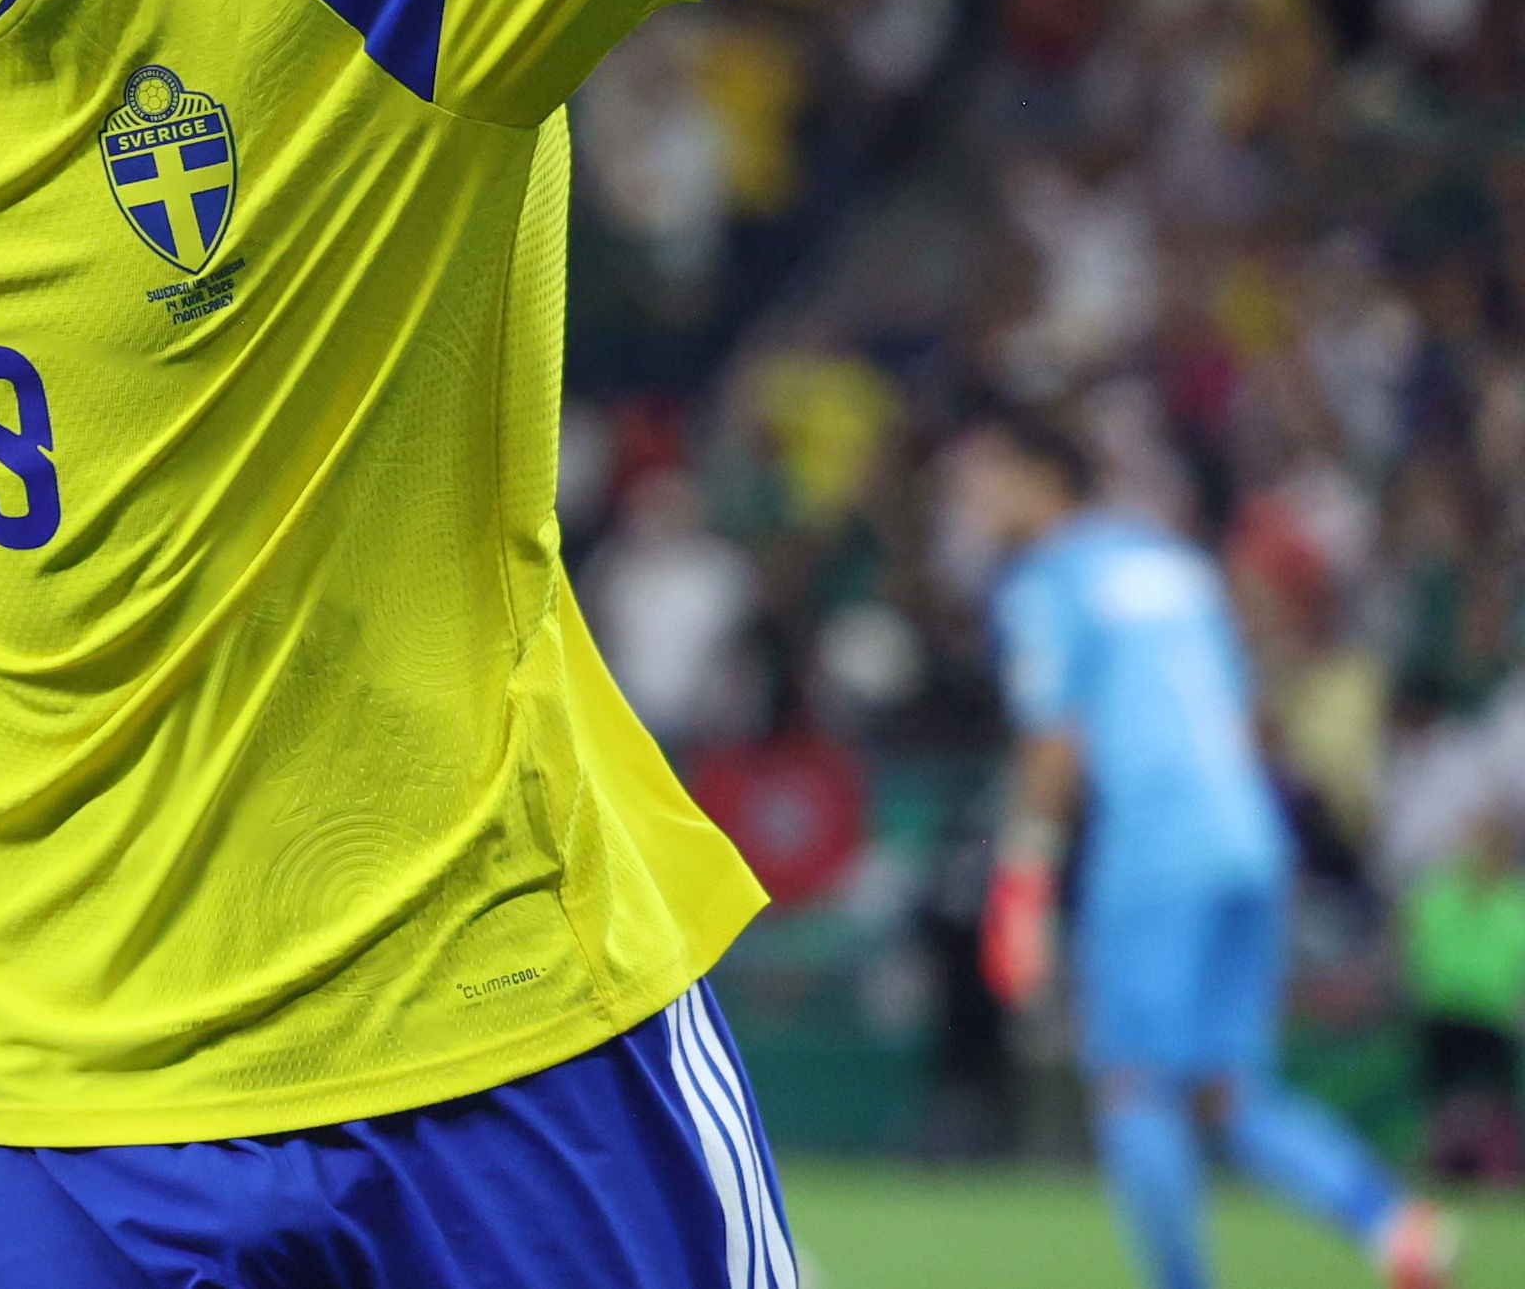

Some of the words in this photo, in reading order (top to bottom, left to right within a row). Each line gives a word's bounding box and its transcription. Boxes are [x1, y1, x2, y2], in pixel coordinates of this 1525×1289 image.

[118, 119, 207, 151] SVERIGE
[146, 281, 190, 303] SWEDEN
[172, 292, 234, 325] MONTERREY
